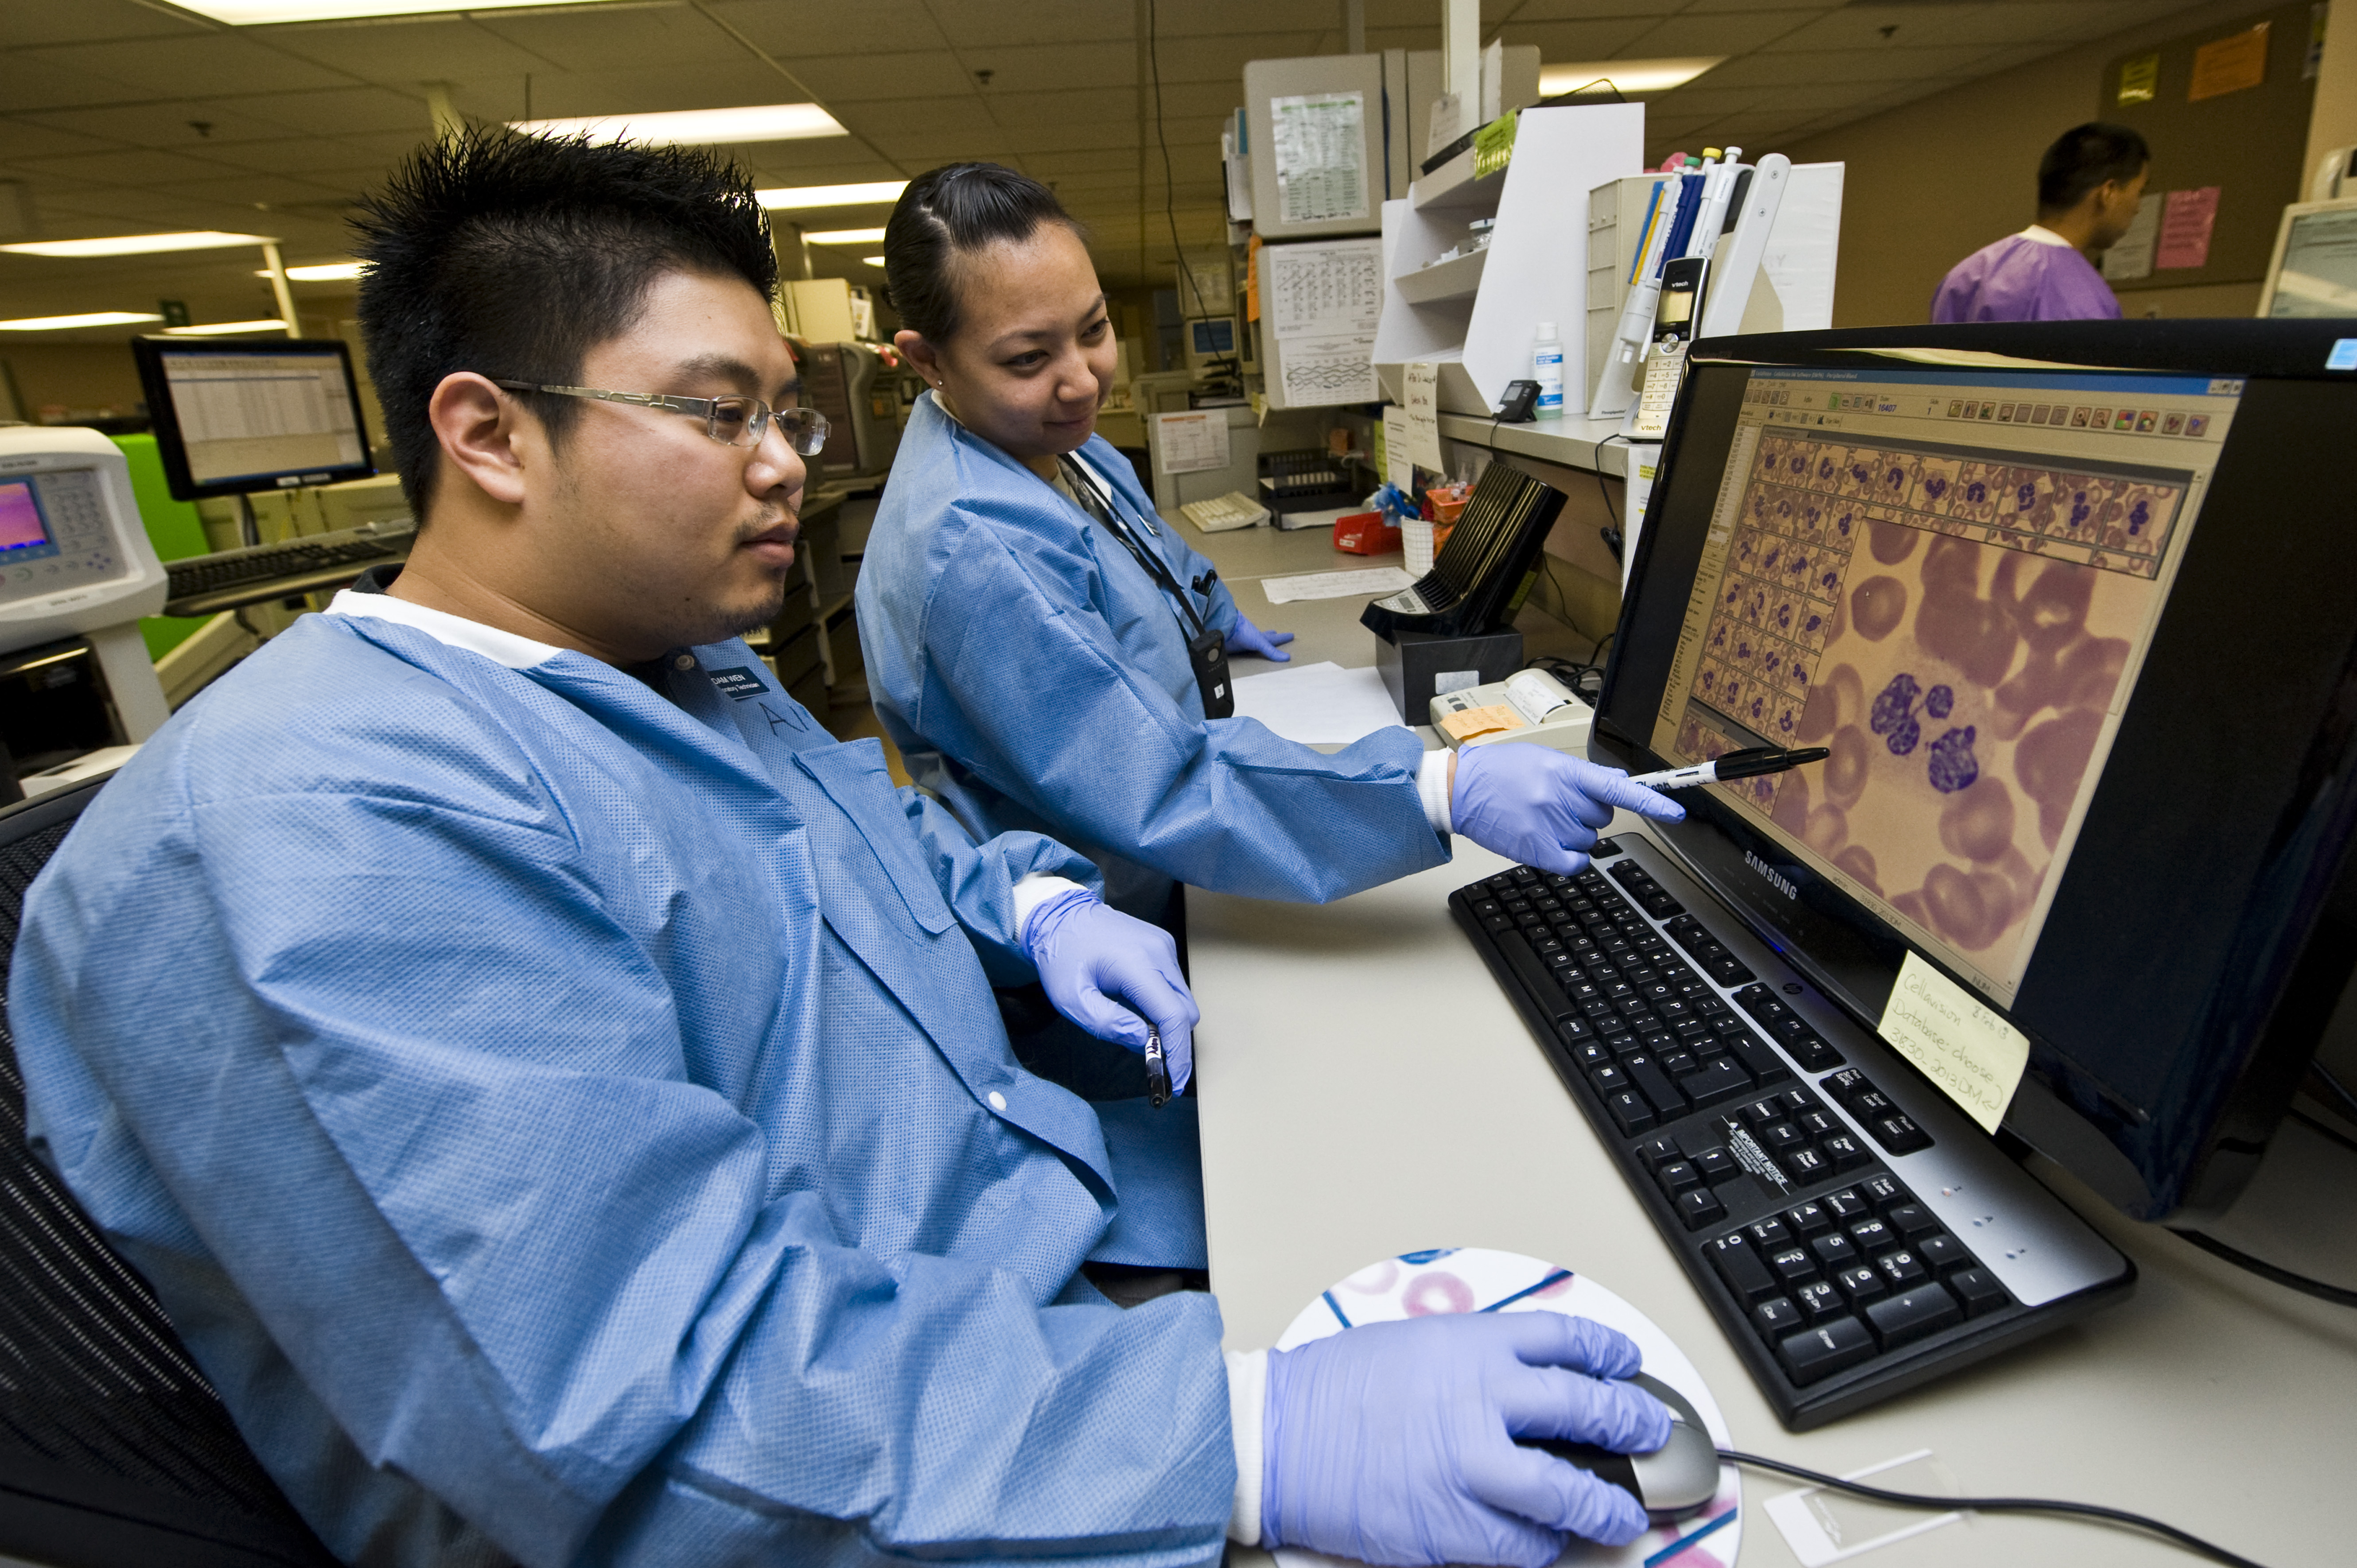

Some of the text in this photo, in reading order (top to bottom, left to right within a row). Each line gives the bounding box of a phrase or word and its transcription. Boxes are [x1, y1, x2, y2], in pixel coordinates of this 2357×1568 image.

[1878, 404, 1897, 412] 16407
[710, 676, 730, 685] DAM
[1745, 850, 1797, 900] SAMSUNG
[1972, 976, 1991, 993] NUM
[1952, 1046, 1994, 1084] choose
[1863, 1095, 1877, 1107] Lock
[1871, 1093, 1887, 1106] Scroll
[1812, 1114, 1828, 1128] Home
[1778, 1128, 1790, 1137] End
[1832, 1140, 1842, 1149] Up
[1840, 1137, 1855, 1151] Page
[1737, 1129, 1788, 1185] IMPORTANT NOTICE
[1797, 1153, 1812, 1168] Down
[1805, 1151, 1818, 1164] Page
[1872, 1180, 1888, 1196] Lock
[1880, 1178, 1895, 1192] Num
[1829, 1196, 1846, 1213] Home
[1754, 1226, 1767, 1237] End
[1869, 1223, 1883, 1232] 8
[1729, 1235, 1741, 1244] 0
[1830, 1238, 1844, 1246] 5
[1789, 1252, 1804, 1262] 2
[1897, 1254, 1910, 1263] 9
[1858, 1271, 1871, 1280] 6
[1816, 1285, 1830, 1295] 3
